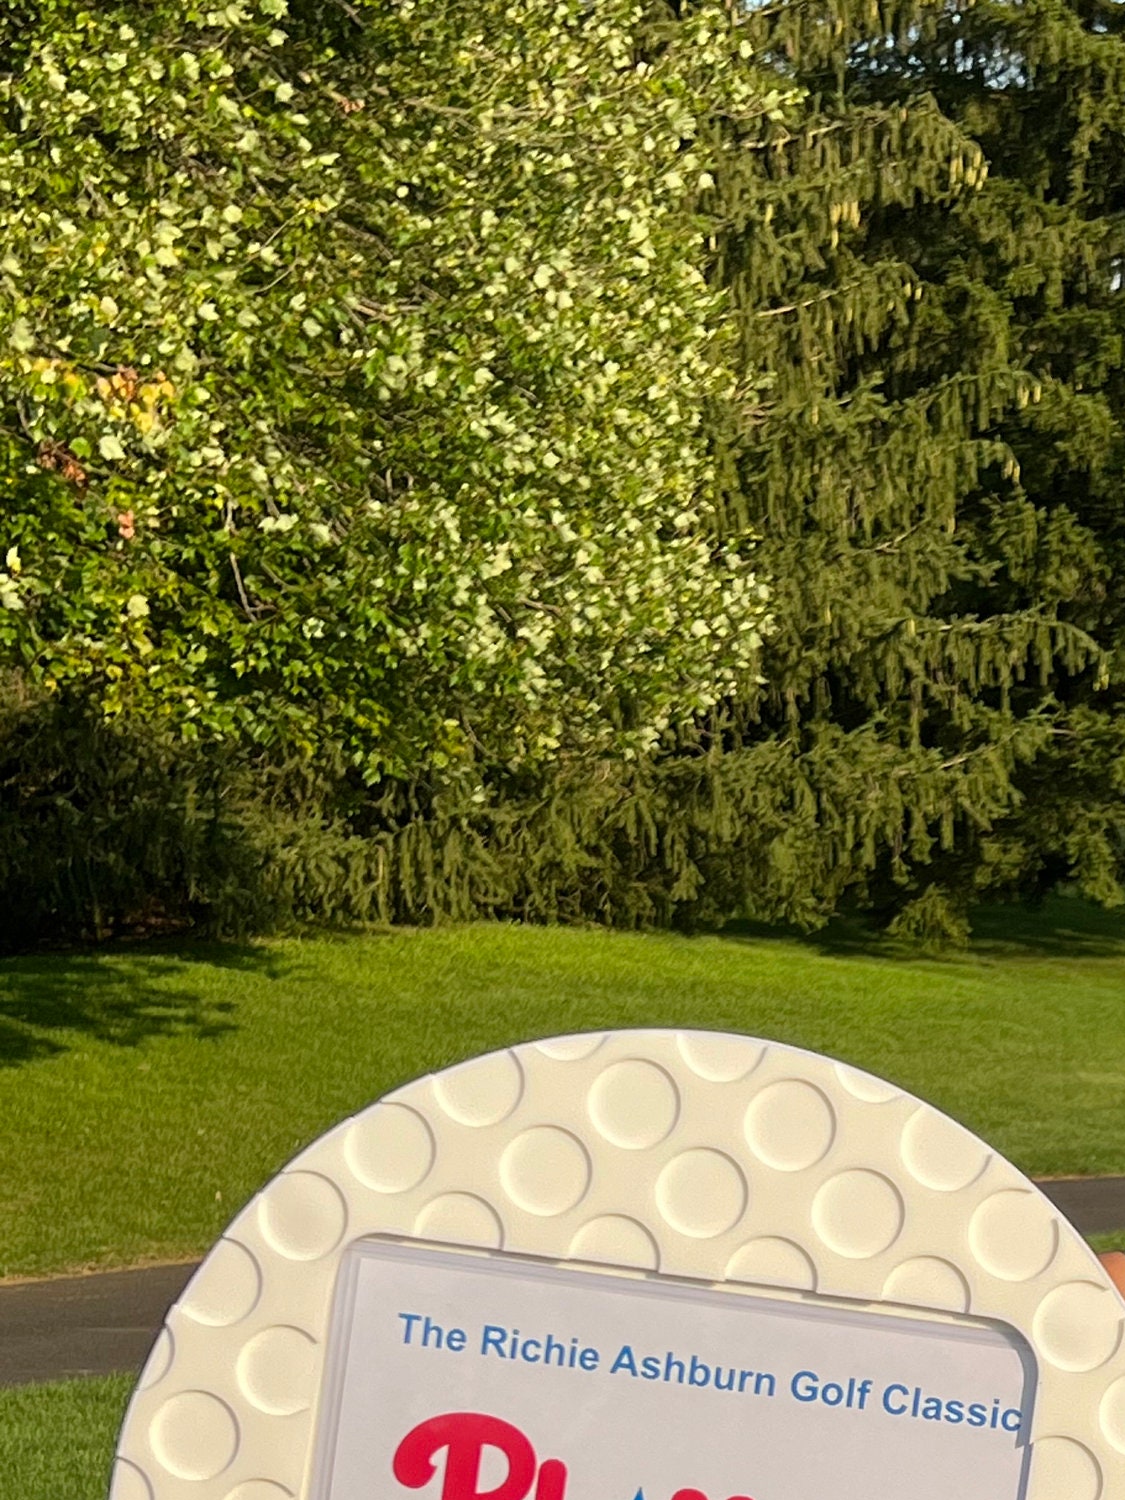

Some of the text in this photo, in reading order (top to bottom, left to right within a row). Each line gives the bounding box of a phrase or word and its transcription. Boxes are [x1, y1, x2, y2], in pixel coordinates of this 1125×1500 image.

[398, 1312, 1023, 1431] The Richie Ashburn Golf Classic
